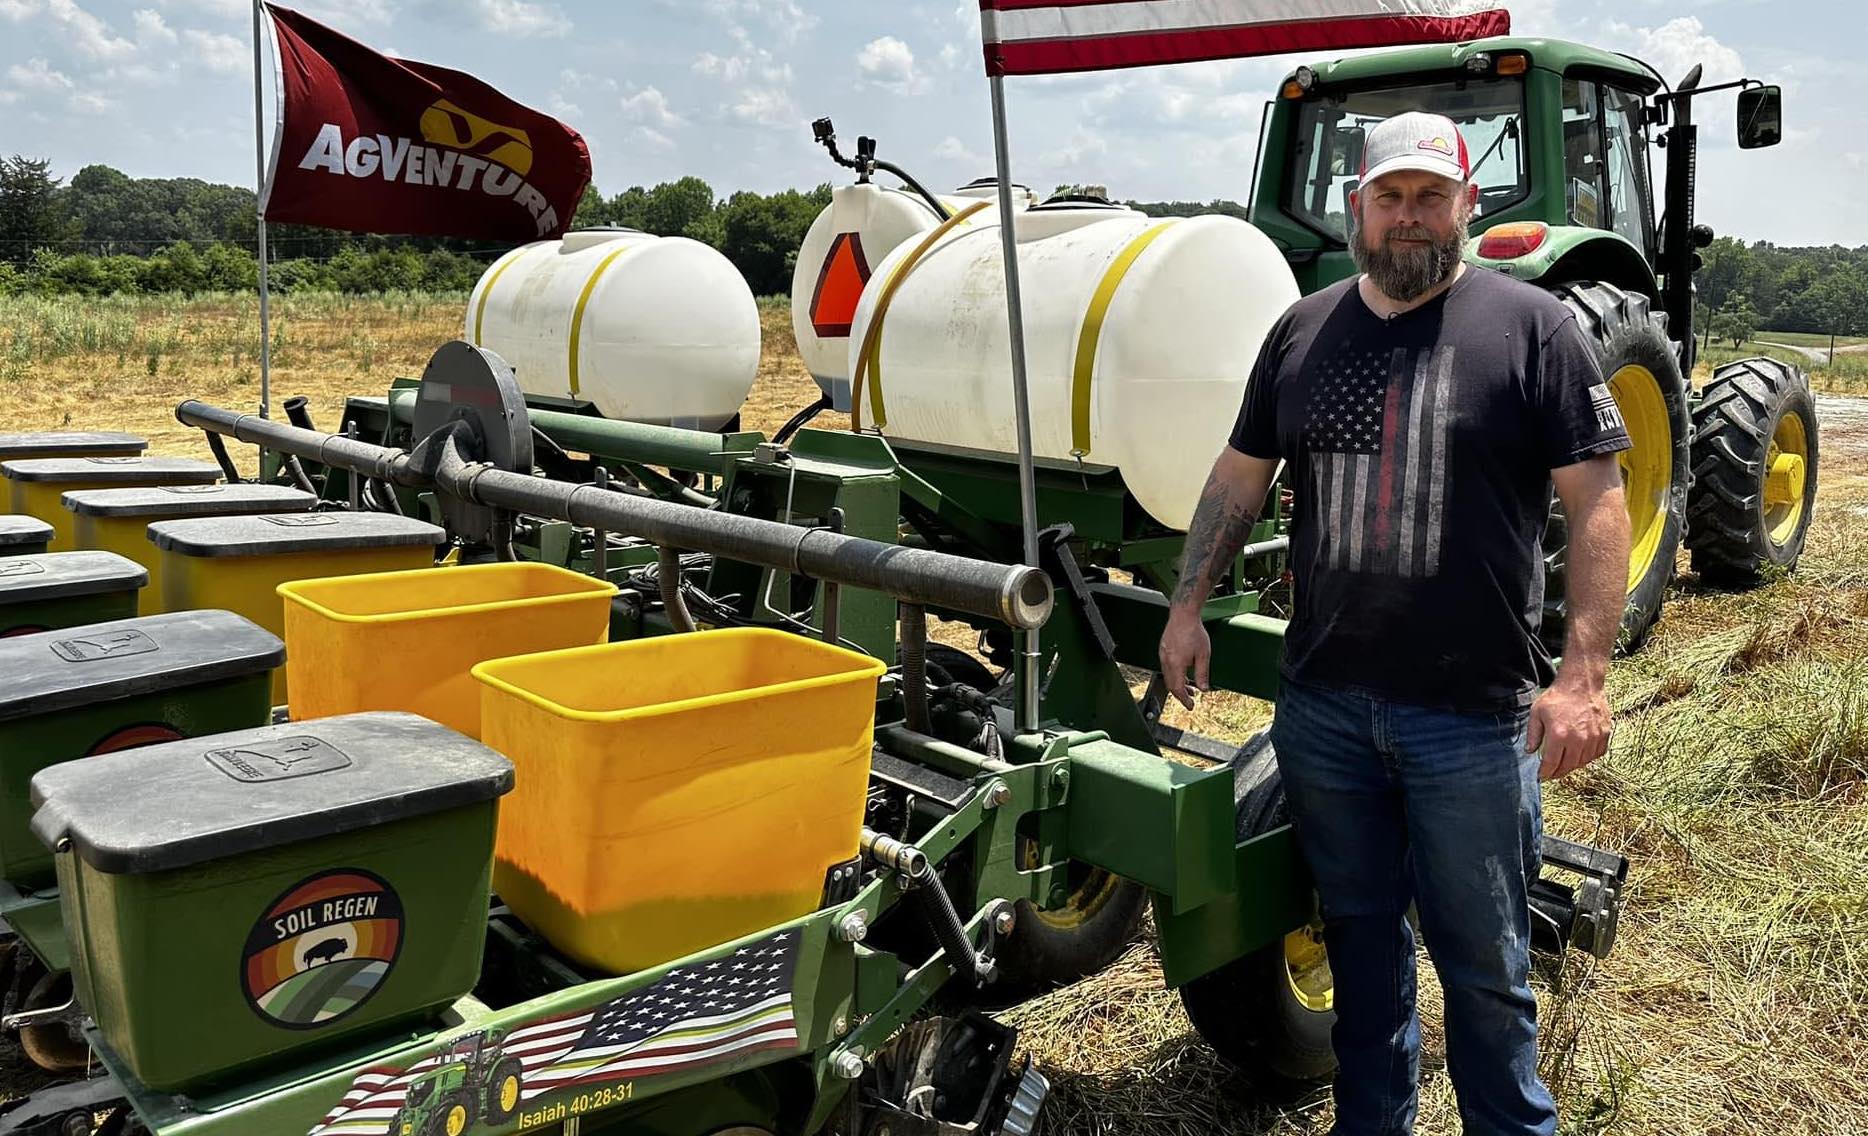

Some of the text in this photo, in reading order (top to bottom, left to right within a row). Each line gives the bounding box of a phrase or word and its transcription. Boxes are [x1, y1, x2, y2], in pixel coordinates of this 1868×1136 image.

[274, 896, 378, 940] SOIL REGEN
[519, 1081, 633, 1129] Isaiah 40:28-31
